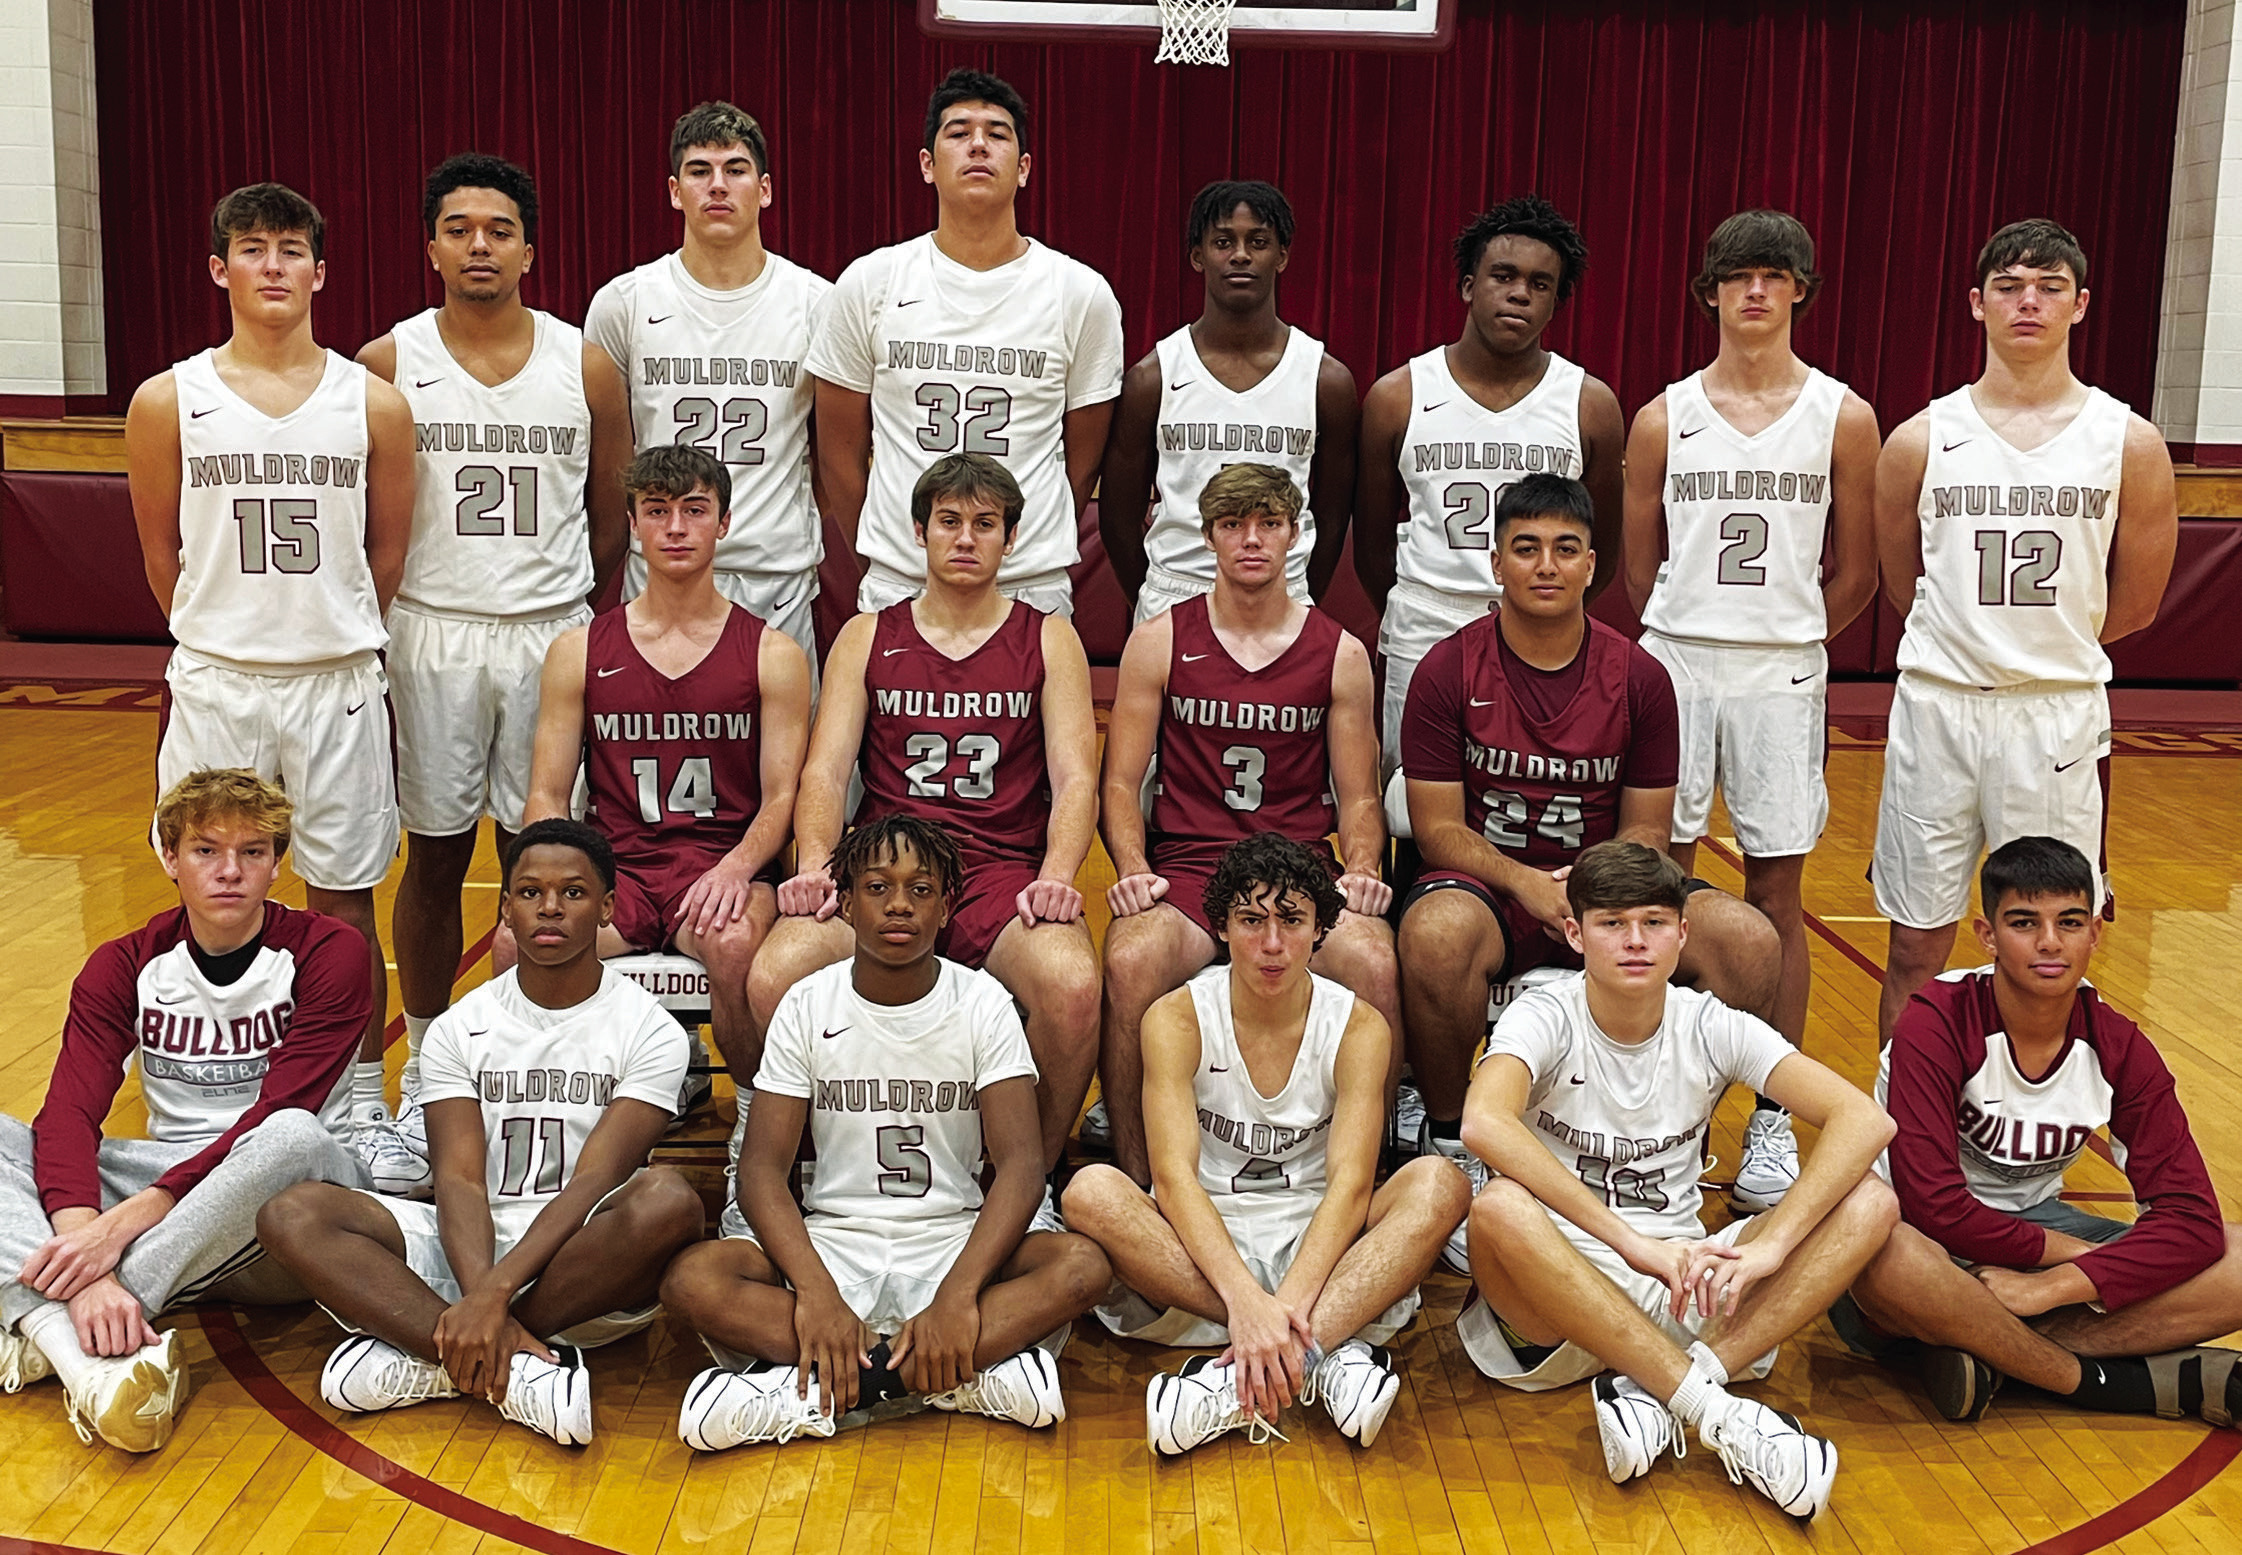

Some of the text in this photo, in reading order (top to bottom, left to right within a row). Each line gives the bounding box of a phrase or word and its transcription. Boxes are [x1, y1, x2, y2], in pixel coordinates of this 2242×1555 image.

[643, 357, 798, 388] MULDROW
[888, 340, 1047, 379] MULDROW
[415, 423, 577, 456] MULDROW
[673, 397, 768, 466] 22
[915, 382, 1013, 457] 32
[1160, 423, 1312, 456] MULDROW
[188, 453, 360, 489] MULDROW
[1414, 442, 1573, 476] MULDROW
[456, 465, 538, 536] 21
[1671, 470, 1826, 504] MULDROW
[1932, 485, 2111, 520] MULDROW
[233, 498, 320, 575] 15
[1717, 513, 1768, 586] 2
[1975, 529, 2063, 606] 12
[592, 712, 751, 742] MULDROW
[875, 688, 1033, 719] MULDROW
[1170, 695, 1326, 734] MULDROW
[903, 732, 1001, 801] 23
[1222, 744, 1266, 813] 3
[1465, 735, 1620, 783] MULDROW
[630, 756, 718, 826] 14
[1481, 788, 1585, 849] 24
[142, 1002, 294, 1056] BULLDOG
[497, 1116, 565, 1197] 11
[876, 1124, 933, 1199] 5
